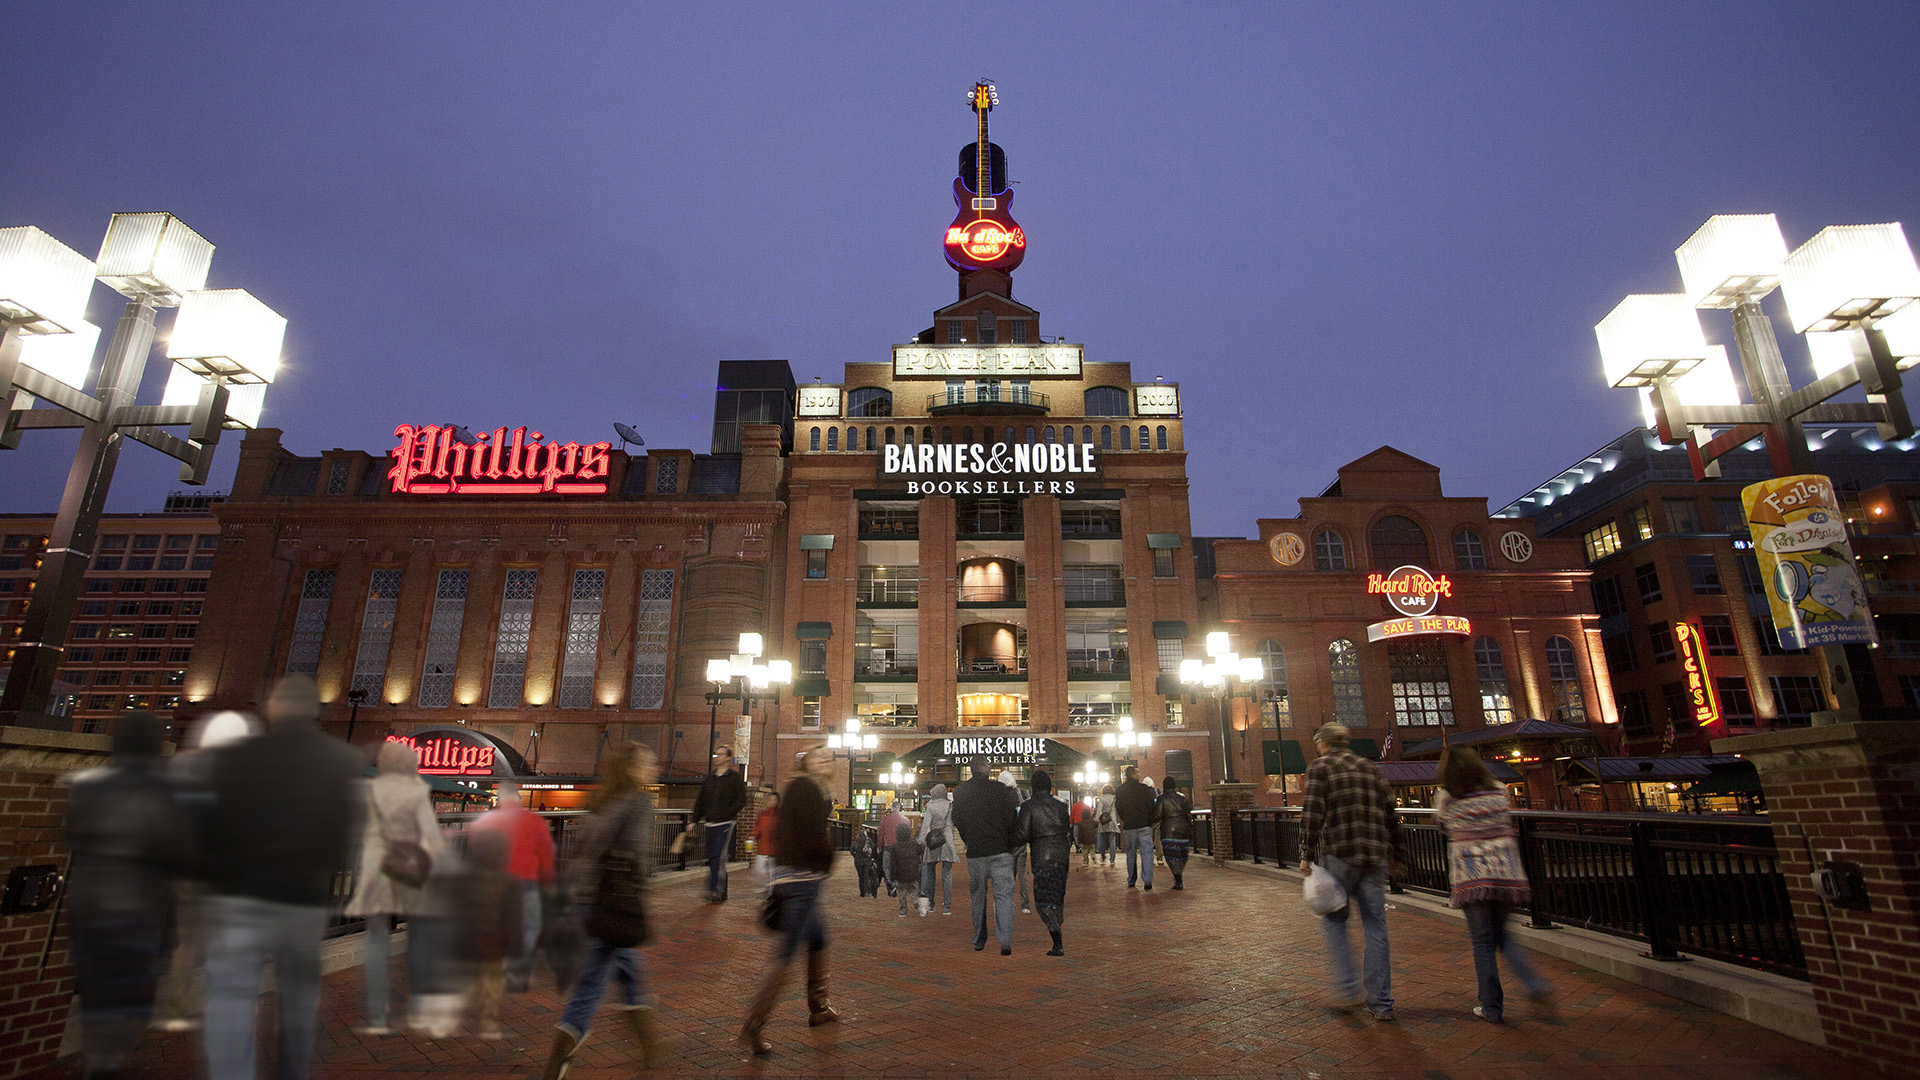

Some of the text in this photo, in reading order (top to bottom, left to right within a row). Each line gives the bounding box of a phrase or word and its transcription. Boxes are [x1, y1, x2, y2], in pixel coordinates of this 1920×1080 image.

[985, 228, 1024, 246] Rock
[971, 244, 999, 254] CAFE
[906, 350, 1073, 371] POWER PLANT
[805, 395, 834, 408] 1900
[1141, 393, 1173, 407] 2000
[388, 423, 612, 494] Phillips
[907, 481, 1075, 495] BOOKSELLERS
[1763, 481, 1830, 514] Follow
[1813, 513, 1824, 522] to
[1768, 532, 1795, 550] Port
[1367, 573, 1452, 598] Hard Rock
[1400, 596, 1427, 606] CAFE
[1383, 620, 1415, 636] SAVE
[1419, 619, 1443, 631] THE
[1789, 630, 1807, 638] Te
[1821, 634, 1837, 642] 35
[1675, 625, 1705, 705] DICK'S
[954, 755, 1036, 764] BOSELLERS
